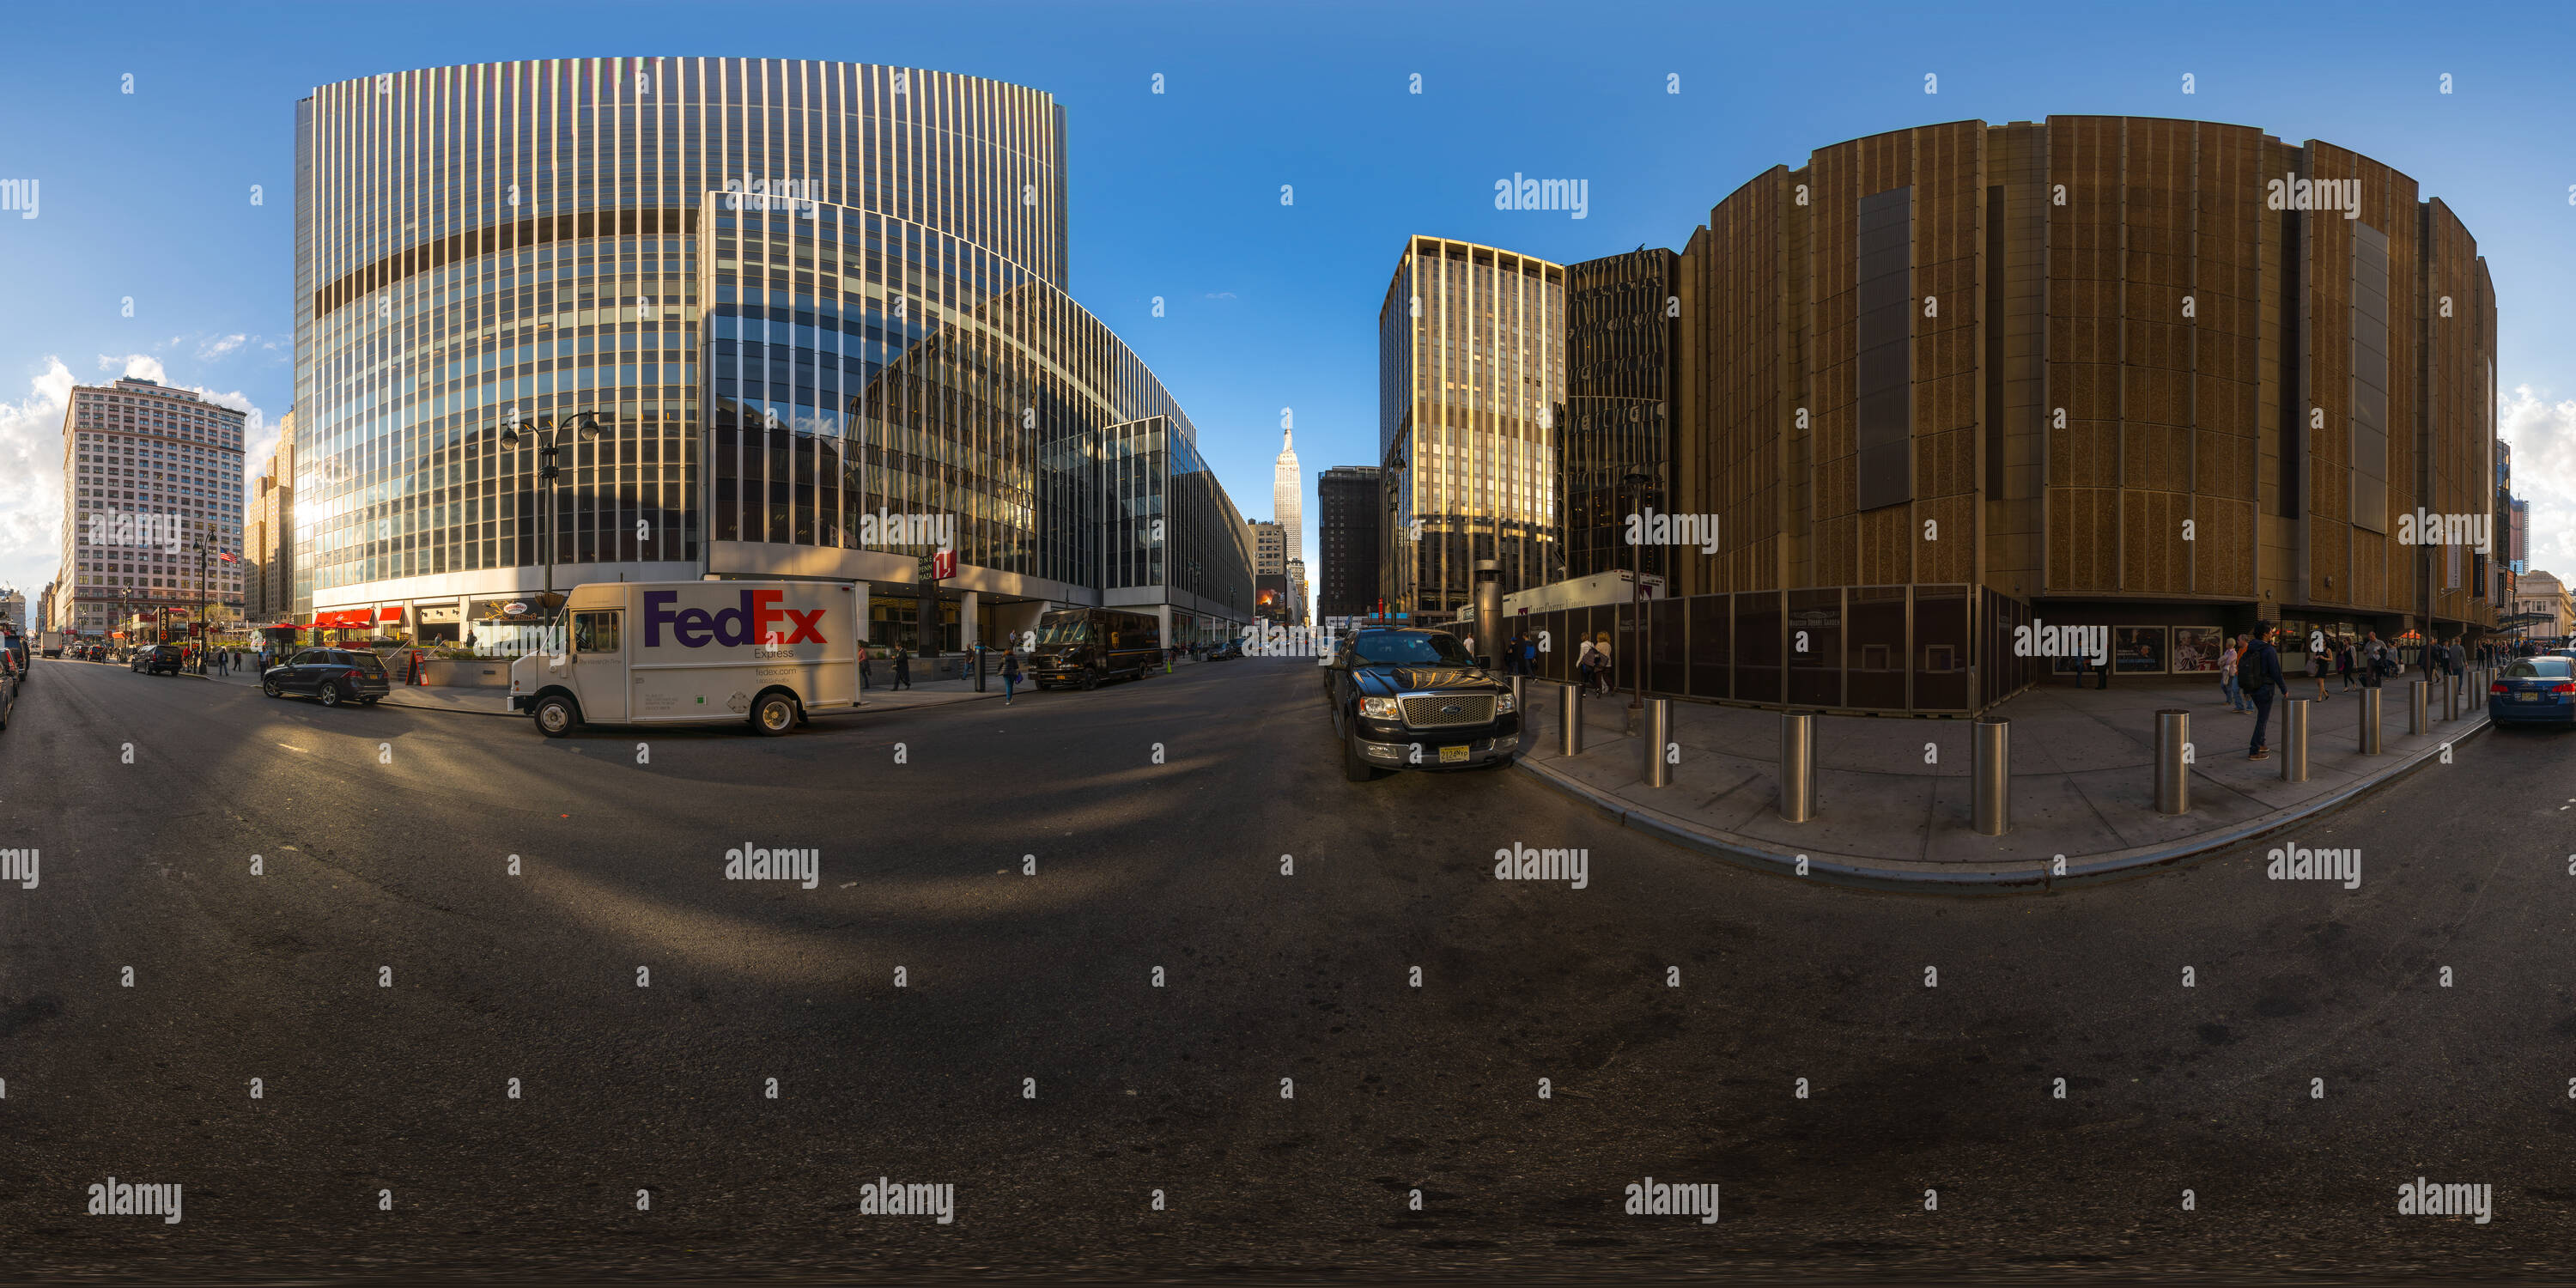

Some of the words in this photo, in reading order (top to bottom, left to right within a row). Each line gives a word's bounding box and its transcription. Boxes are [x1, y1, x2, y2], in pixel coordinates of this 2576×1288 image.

[918, 555, 933, 565] ONE
[918, 563, 933, 573] PENN
[918, 572, 933, 581] PLAZA
[644, 589, 828, 648] FedEx
[755, 648, 794, 660] Express
[756, 668, 797, 677] fedex.com
